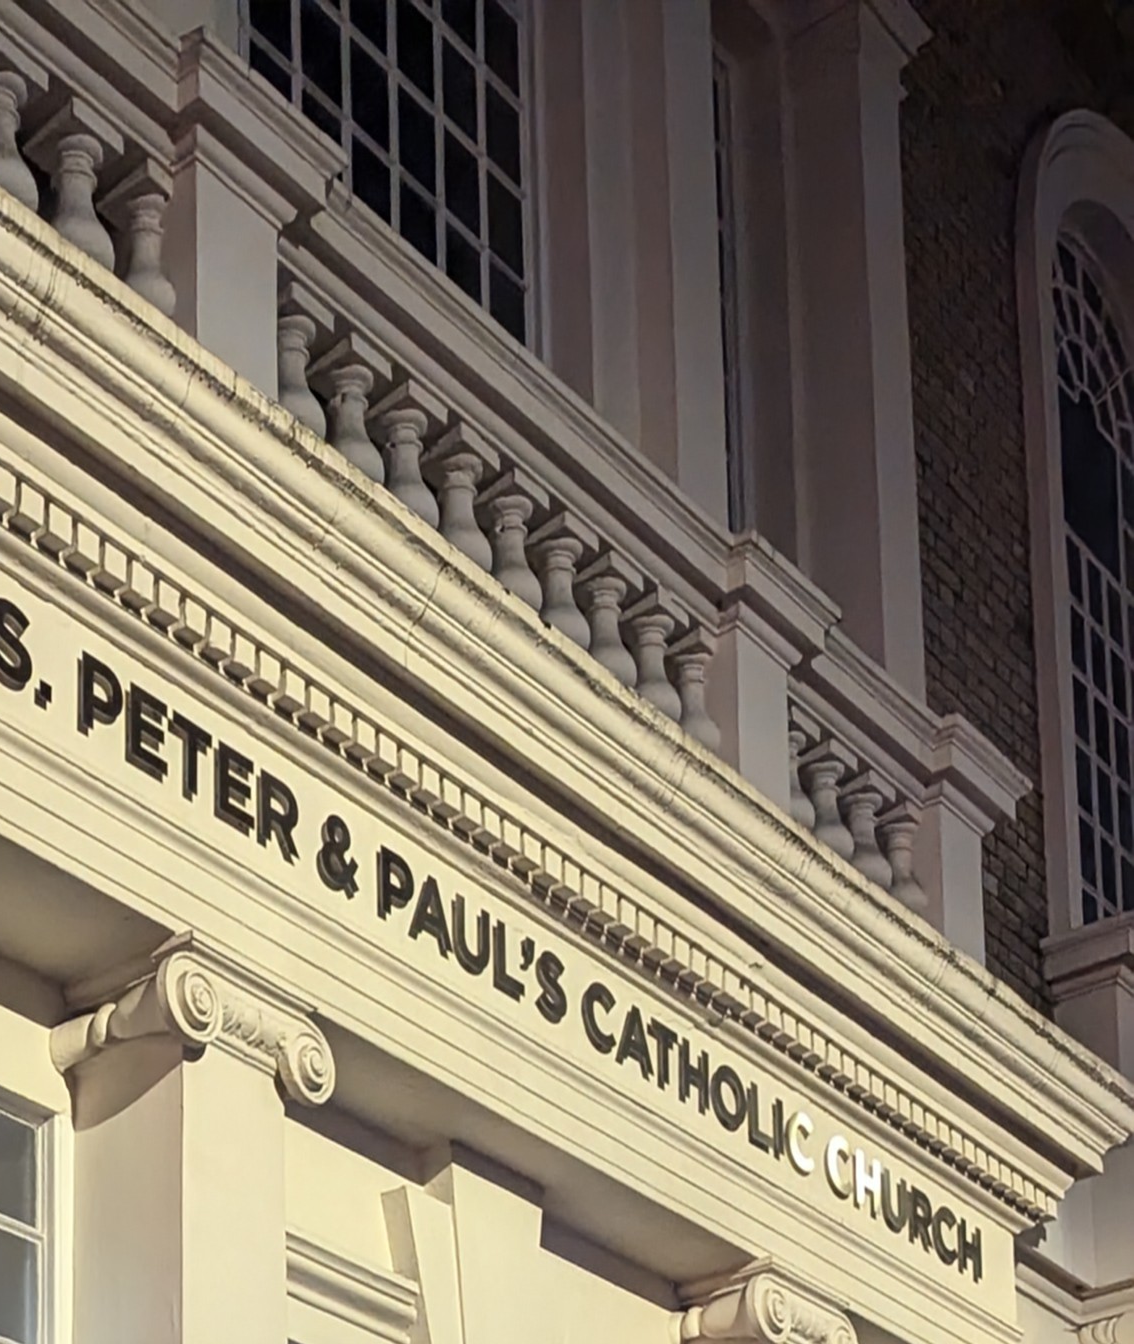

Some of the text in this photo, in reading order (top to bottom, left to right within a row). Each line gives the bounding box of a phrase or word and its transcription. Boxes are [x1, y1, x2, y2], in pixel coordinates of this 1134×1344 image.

[76, 650, 300, 865] PETER
[316, 814, 359, 899] &
[376, 844, 567, 1024] PAUL'S
[581, 981, 815, 1176] CATHOLIC
[823, 1134, 983, 1283] CHURCH
